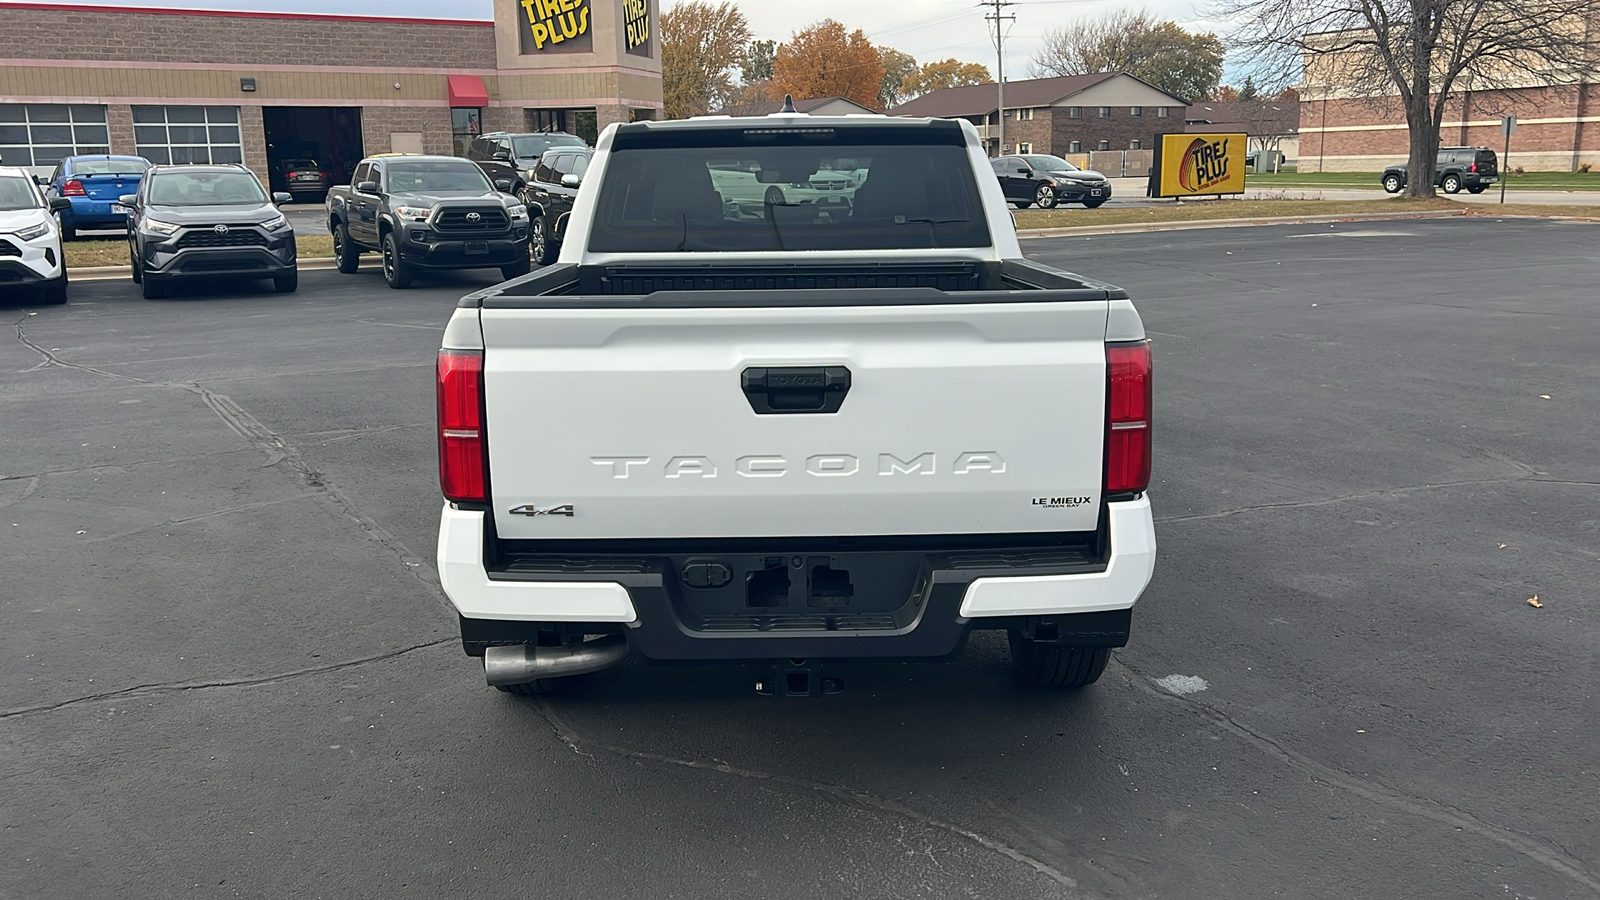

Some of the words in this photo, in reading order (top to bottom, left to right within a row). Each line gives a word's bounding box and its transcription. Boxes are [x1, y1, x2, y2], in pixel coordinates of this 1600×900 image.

[521, 0, 582, 24] TIRE
[531, 6, 589, 49] PLUS
[627, 14, 649, 49] PLUS
[1192, 137, 1228, 167] TIRES
[1196, 156, 1229, 185] PLUS
[770, 375, 822, 386] TOYOTA
[590, 451, 1006, 479] TACOMA
[1050, 496, 1091, 505] MIEUX
